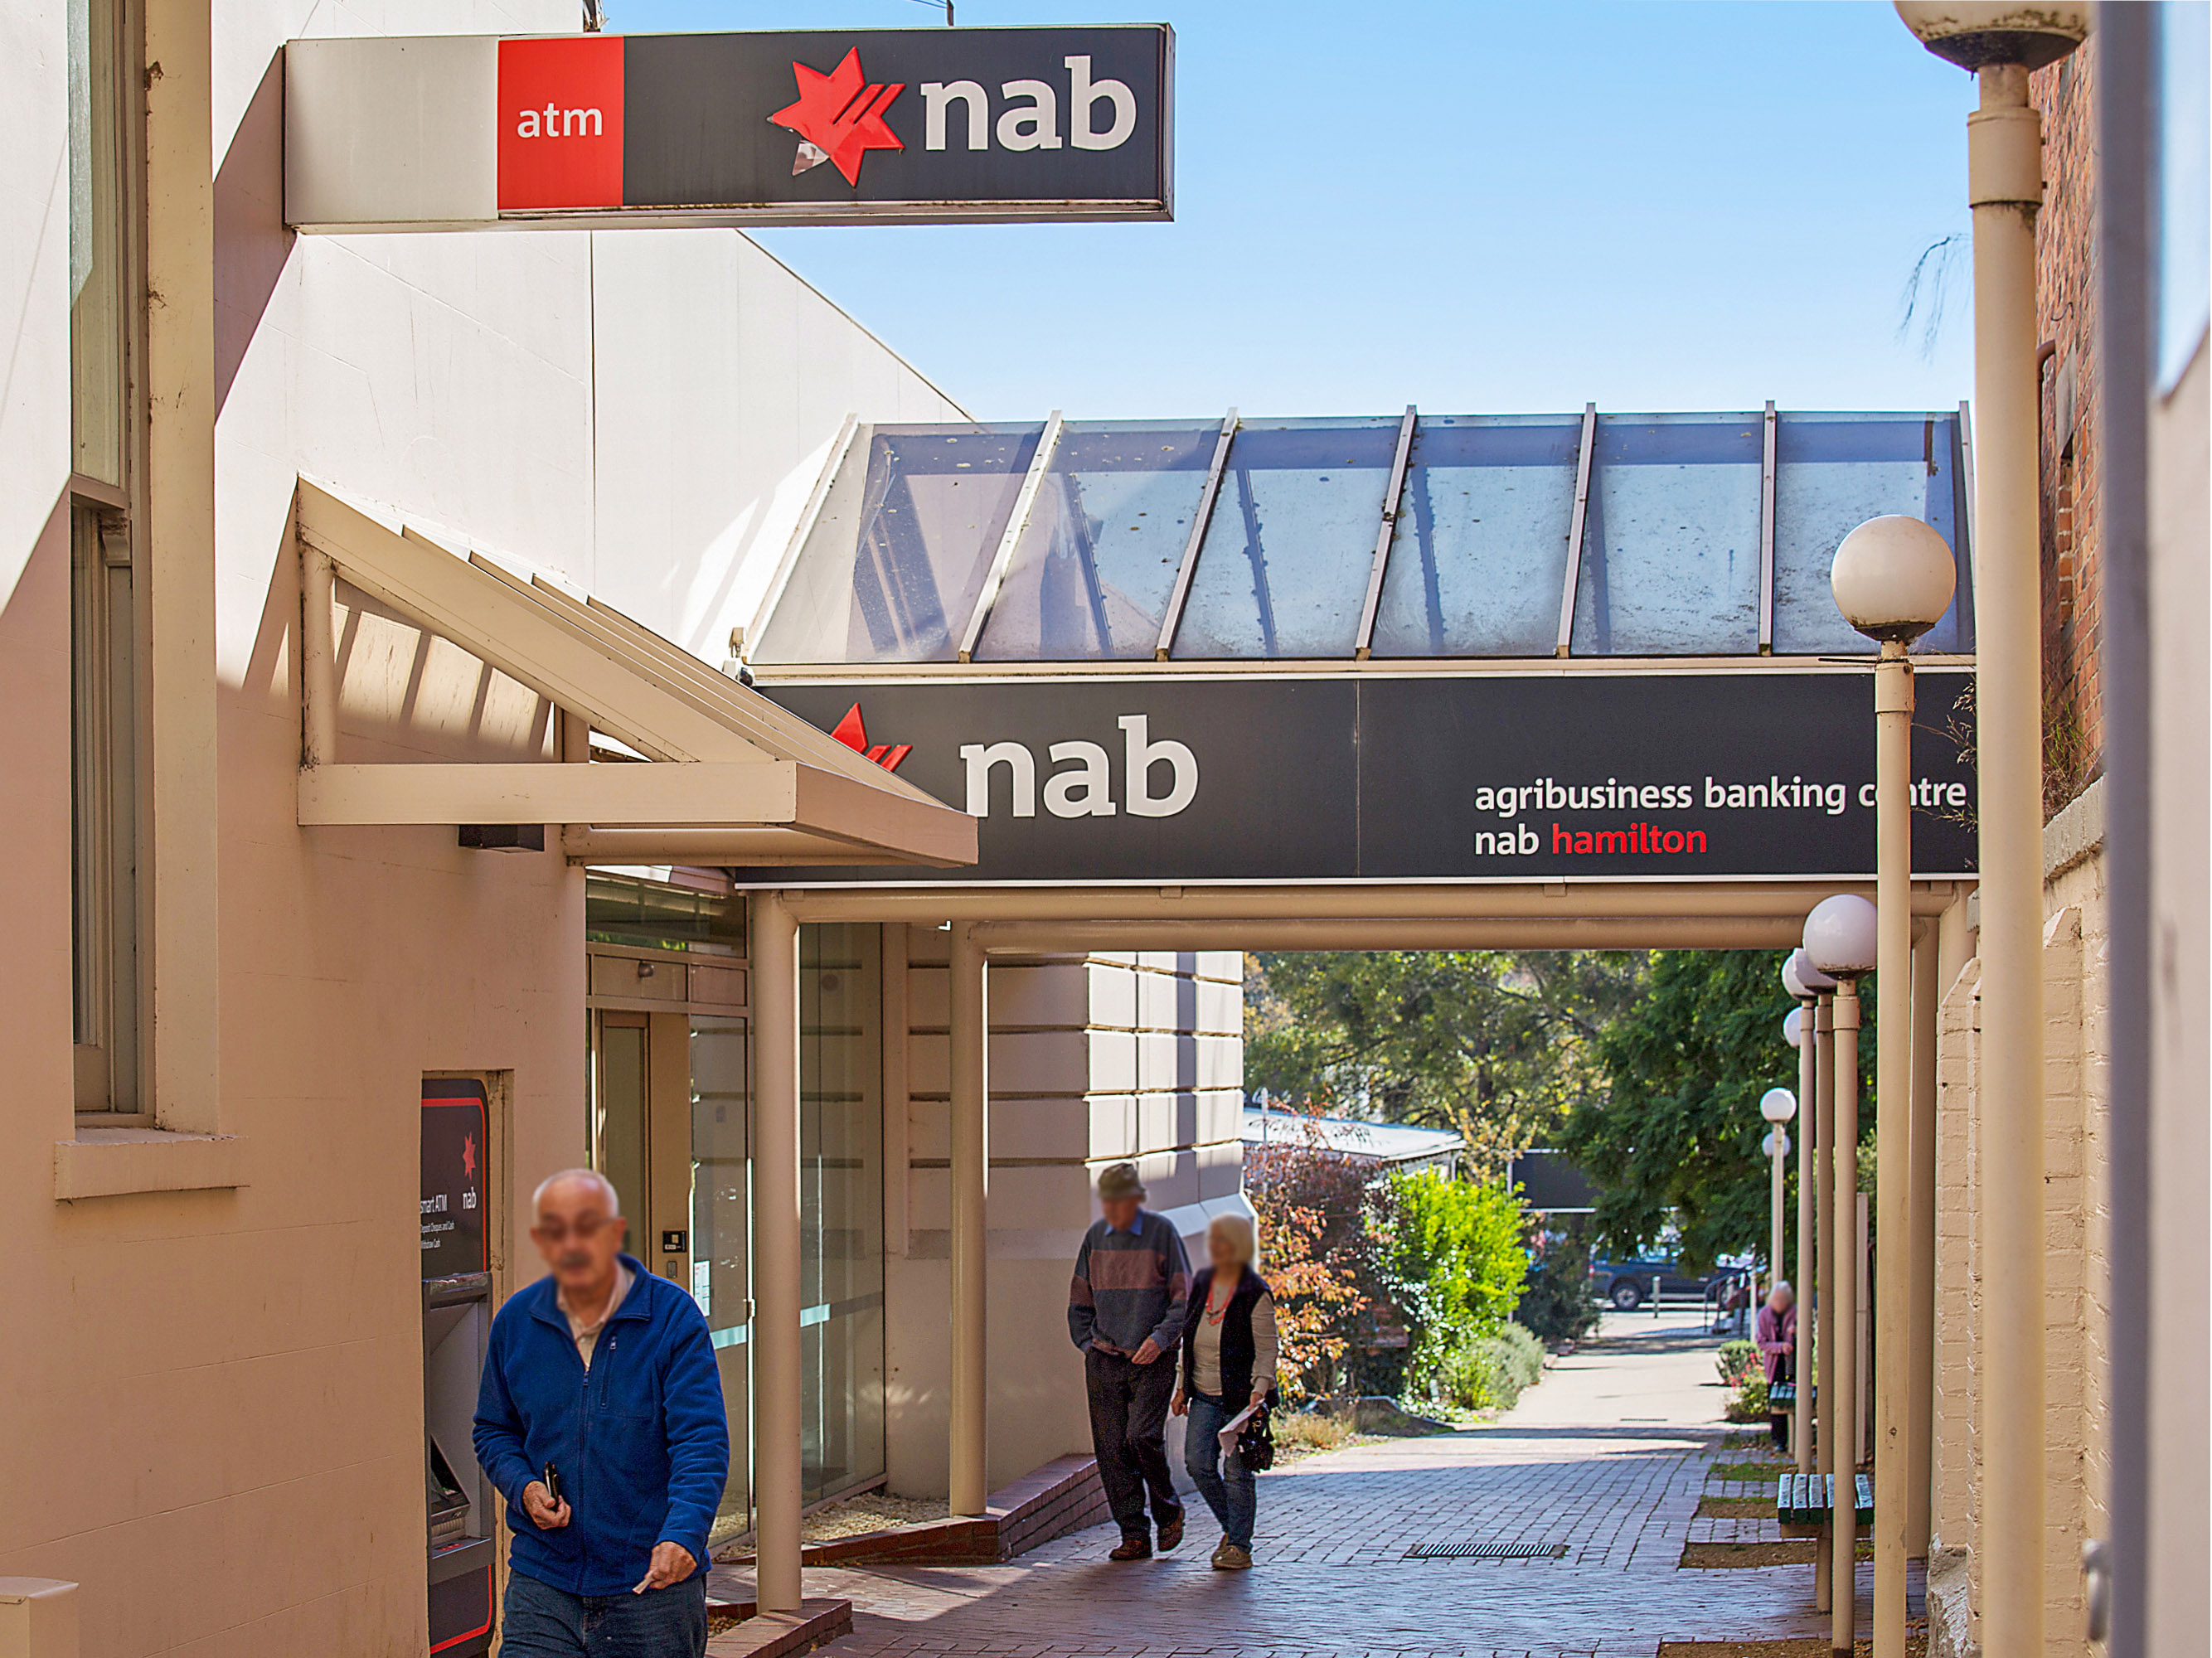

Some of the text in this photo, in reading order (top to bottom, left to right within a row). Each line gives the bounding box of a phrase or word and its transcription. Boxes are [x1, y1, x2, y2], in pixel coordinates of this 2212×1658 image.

[517, 103, 604, 138] atm
[920, 55, 1138, 151] nab
[960, 714, 1199, 818] nab
[1475, 775, 1967, 818] agribusiness banking ctre
[1474, 822, 1708, 856] nab hamilton
[435, 1194, 448, 1212] ATM
[463, 1186, 477, 1210] nab
